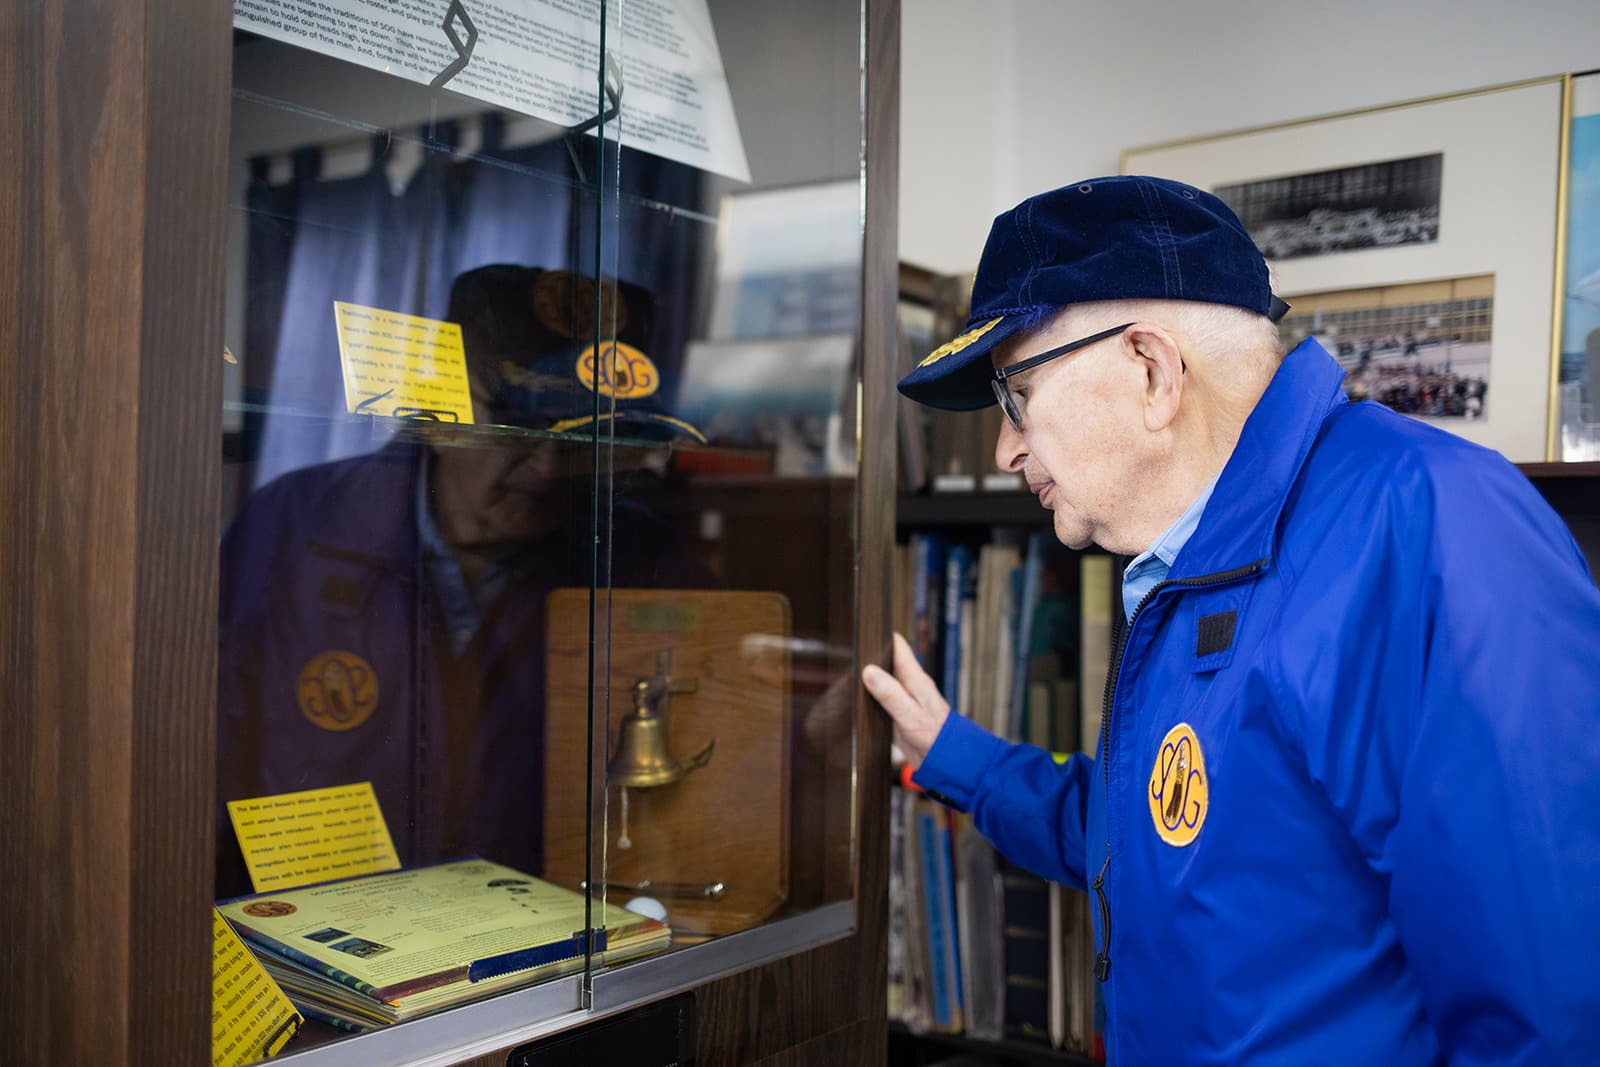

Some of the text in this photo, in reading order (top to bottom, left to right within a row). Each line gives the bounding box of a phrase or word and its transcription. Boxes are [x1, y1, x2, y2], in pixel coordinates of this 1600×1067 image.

[232, 7, 282, 28] stinguished
[282, 22, 308, 38] group
[308, 29, 318, 39] of
[238, 0, 268, 14] remain
[270, 7, 280, 18] to
[280, 10, 300, 24] hold
[301, 17, 314, 28] our
[316, 21, 340, 36] heads
[340, 29, 360, 44] high,
[361, 35, 394, 54] knowing
[394, 47, 406, 57] we
[282, 0, 296, 11] are
[297, 4, 336, 25] beginning
[338, 18, 346, 28] to
[318, 1, 332, 12] the
[333, 6, 370, 25] traditions
[370, 18, 378, 28] of
[397, 27, 414, 40] have
[416, 33, 448, 50] remained
[583, 344, 651, 395] SOG
[1152, 735, 1202, 832] SOG
